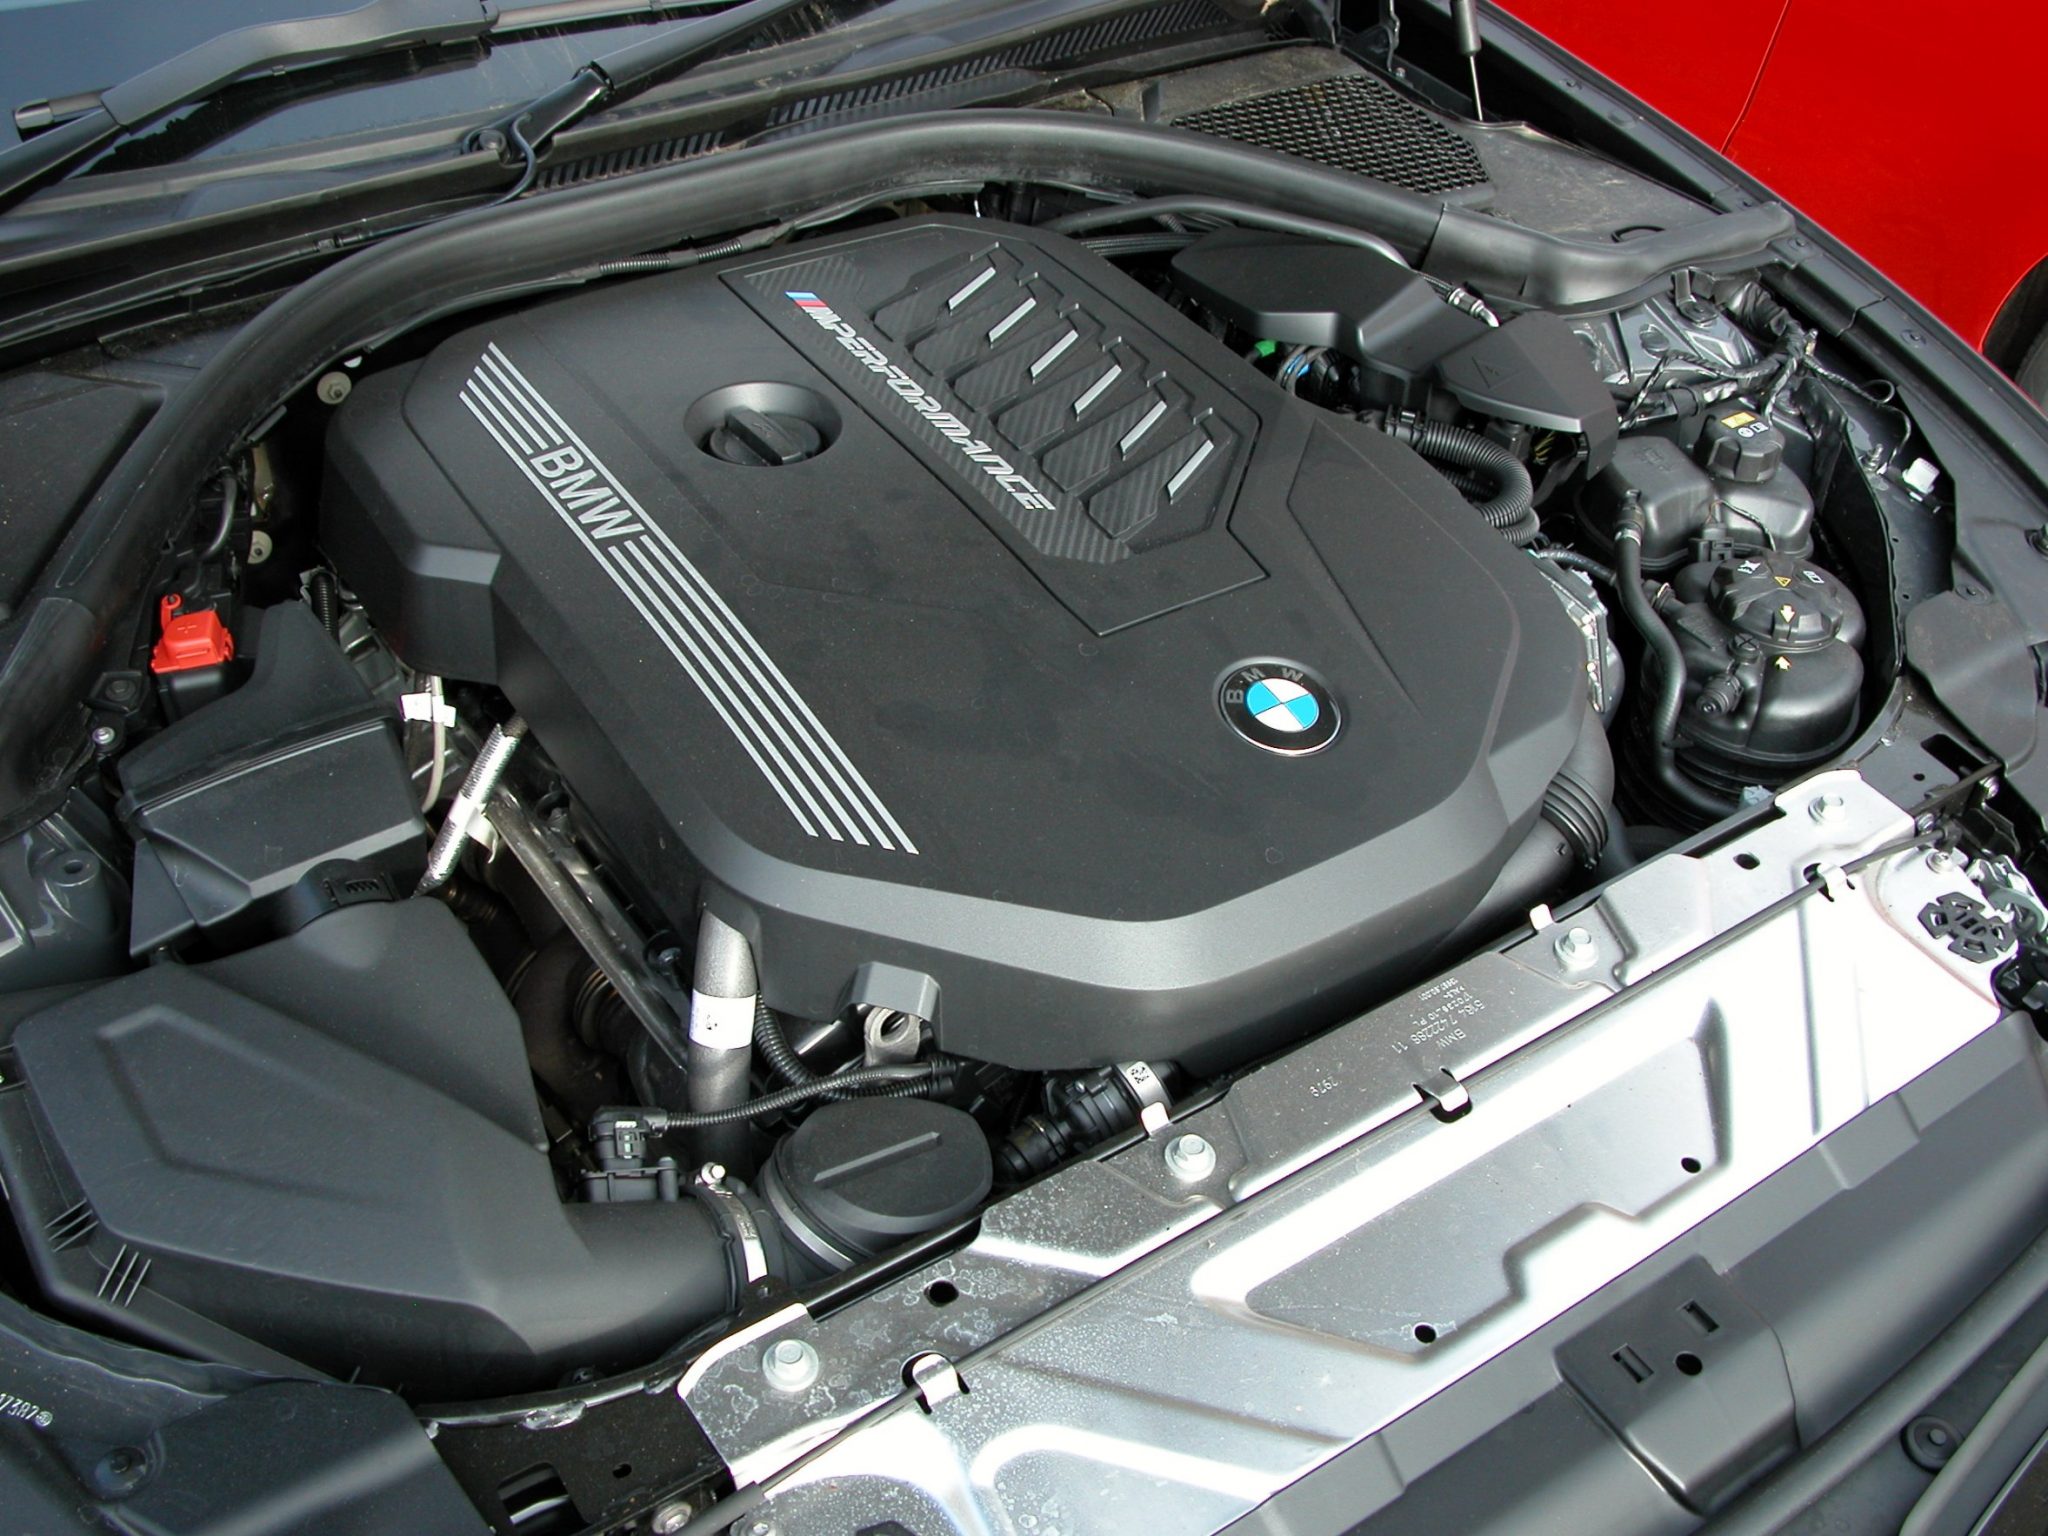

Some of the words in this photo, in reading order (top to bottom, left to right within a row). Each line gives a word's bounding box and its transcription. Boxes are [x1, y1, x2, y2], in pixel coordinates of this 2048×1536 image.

[528, 445, 646, 540] BMW
[1225, 666, 1305, 705] BMW
[1436, 1028, 1467, 1049] BMW
